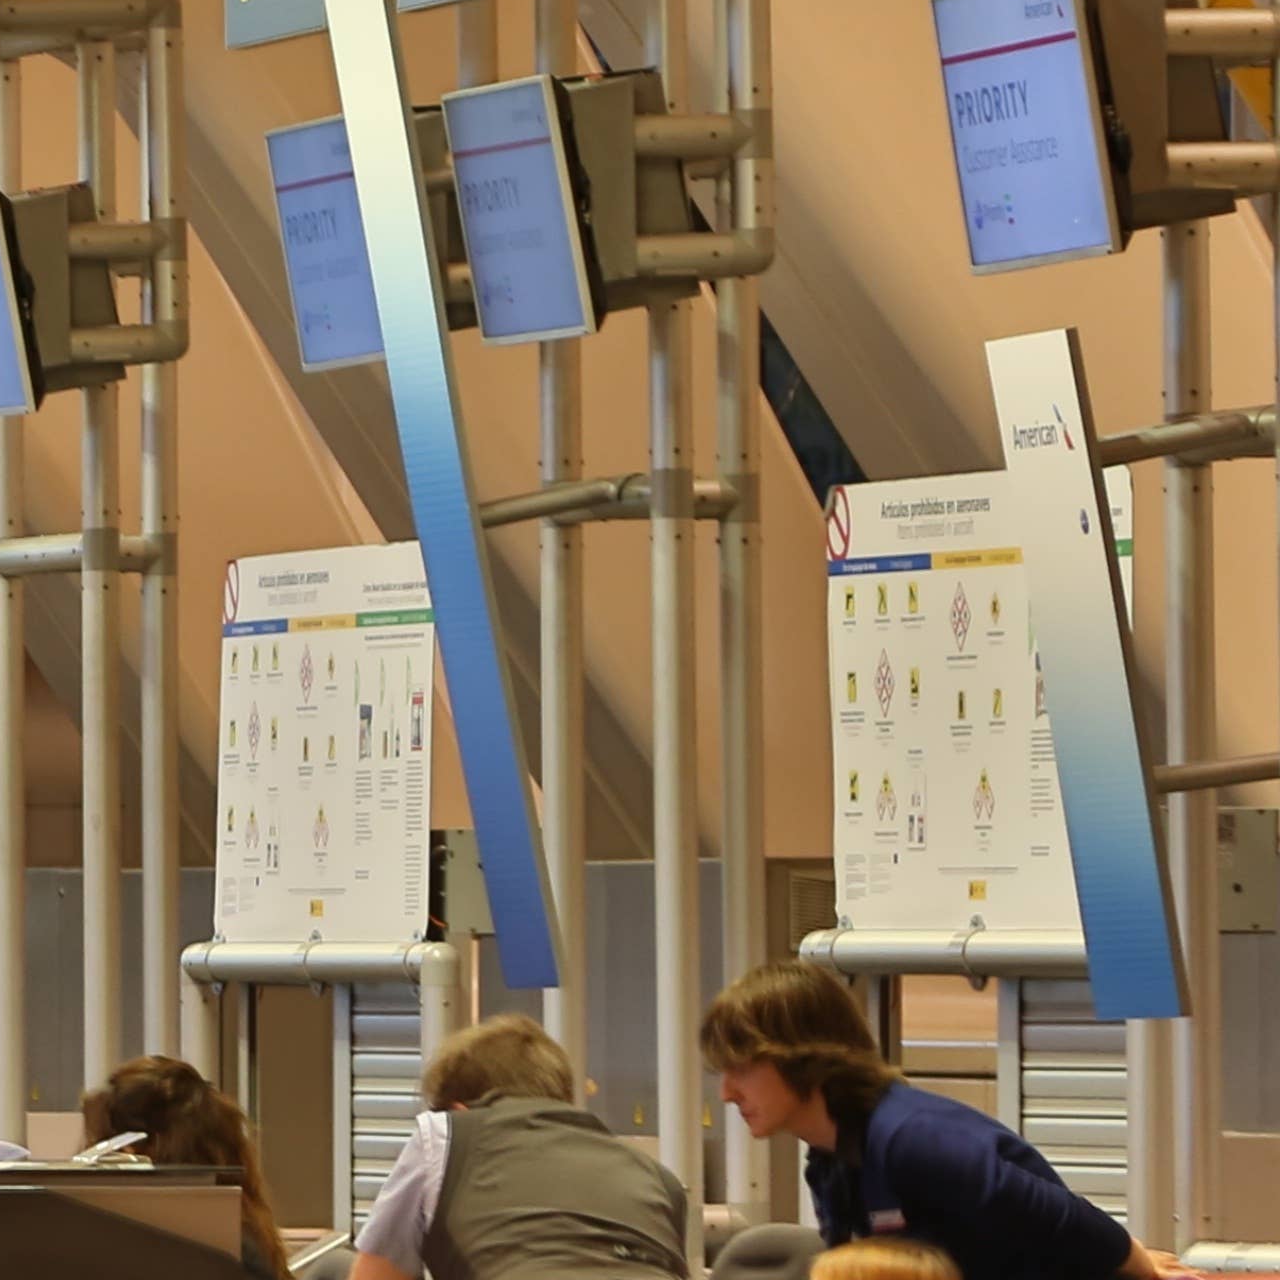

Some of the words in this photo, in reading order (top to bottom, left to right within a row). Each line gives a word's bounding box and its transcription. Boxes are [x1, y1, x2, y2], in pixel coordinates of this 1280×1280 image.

[955, 80, 1029, 129] PRIORITY
[962, 140, 1009, 174] Customer
[1010, 136, 1060, 164] Assistance
[1012, 422, 1059, 450] American
